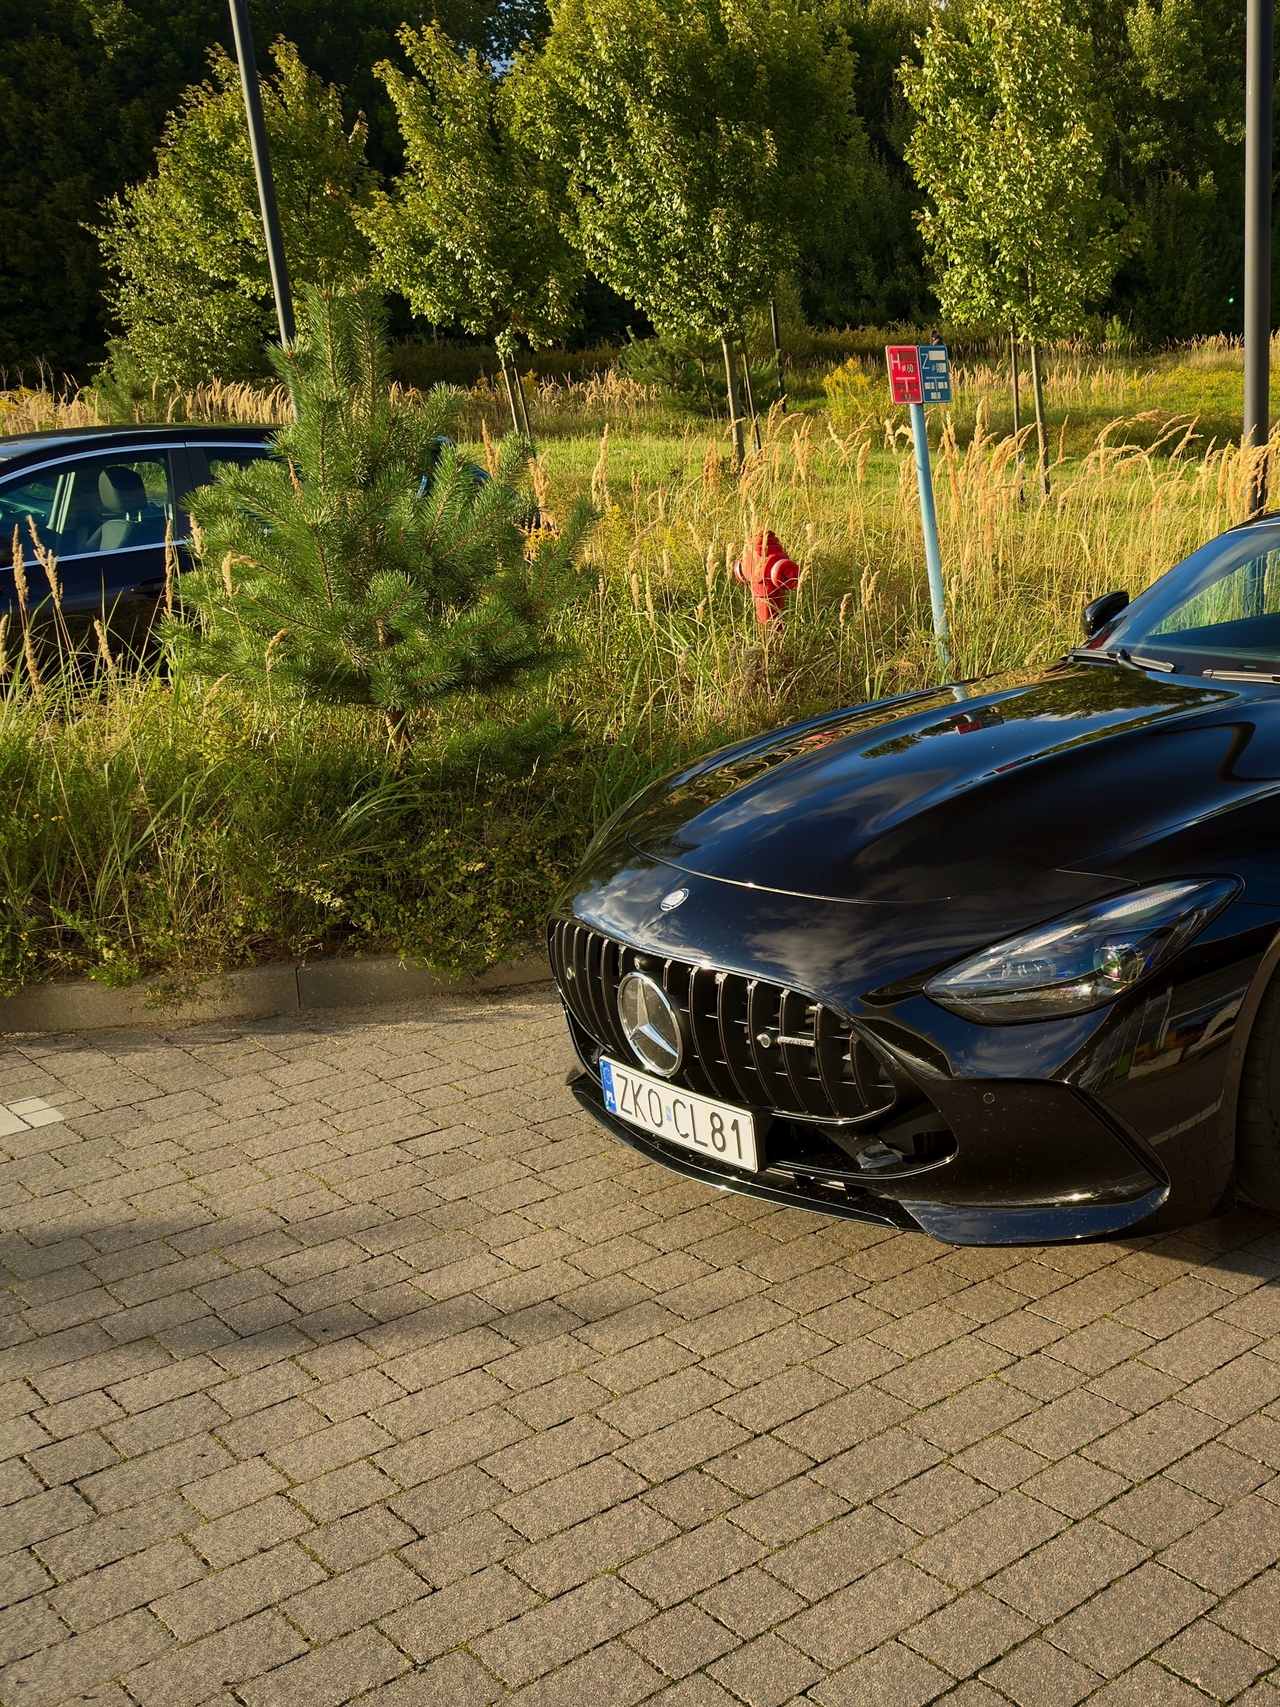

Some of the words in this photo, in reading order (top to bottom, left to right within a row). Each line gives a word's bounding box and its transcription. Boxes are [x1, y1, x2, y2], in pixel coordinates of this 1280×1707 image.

[890, 353, 901, 370] H
[920, 353, 930, 370] Z
[616, 1073, 663, 1128] ZKO
[672, 1098, 743, 1160] CL81
